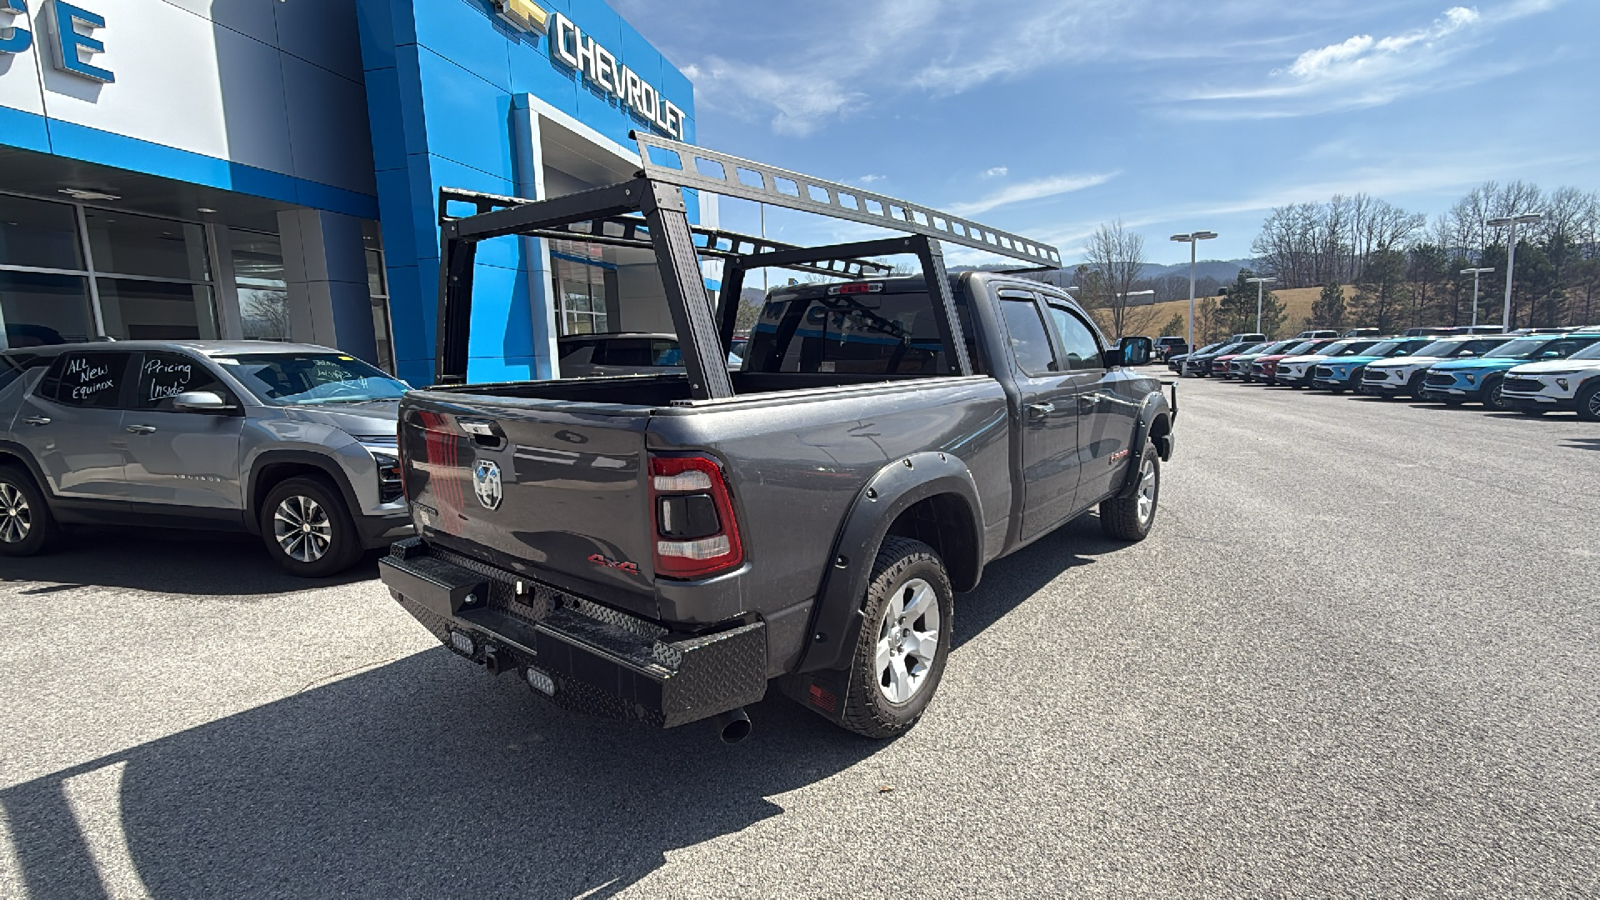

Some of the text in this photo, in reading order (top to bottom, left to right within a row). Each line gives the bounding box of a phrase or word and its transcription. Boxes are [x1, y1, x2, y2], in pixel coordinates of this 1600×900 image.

[555, 12, 686, 142] CHEVROLET
[80, 364, 109, 383] New
[145, 359, 192, 384] Pricing
[150, 377, 185, 399] Inside
